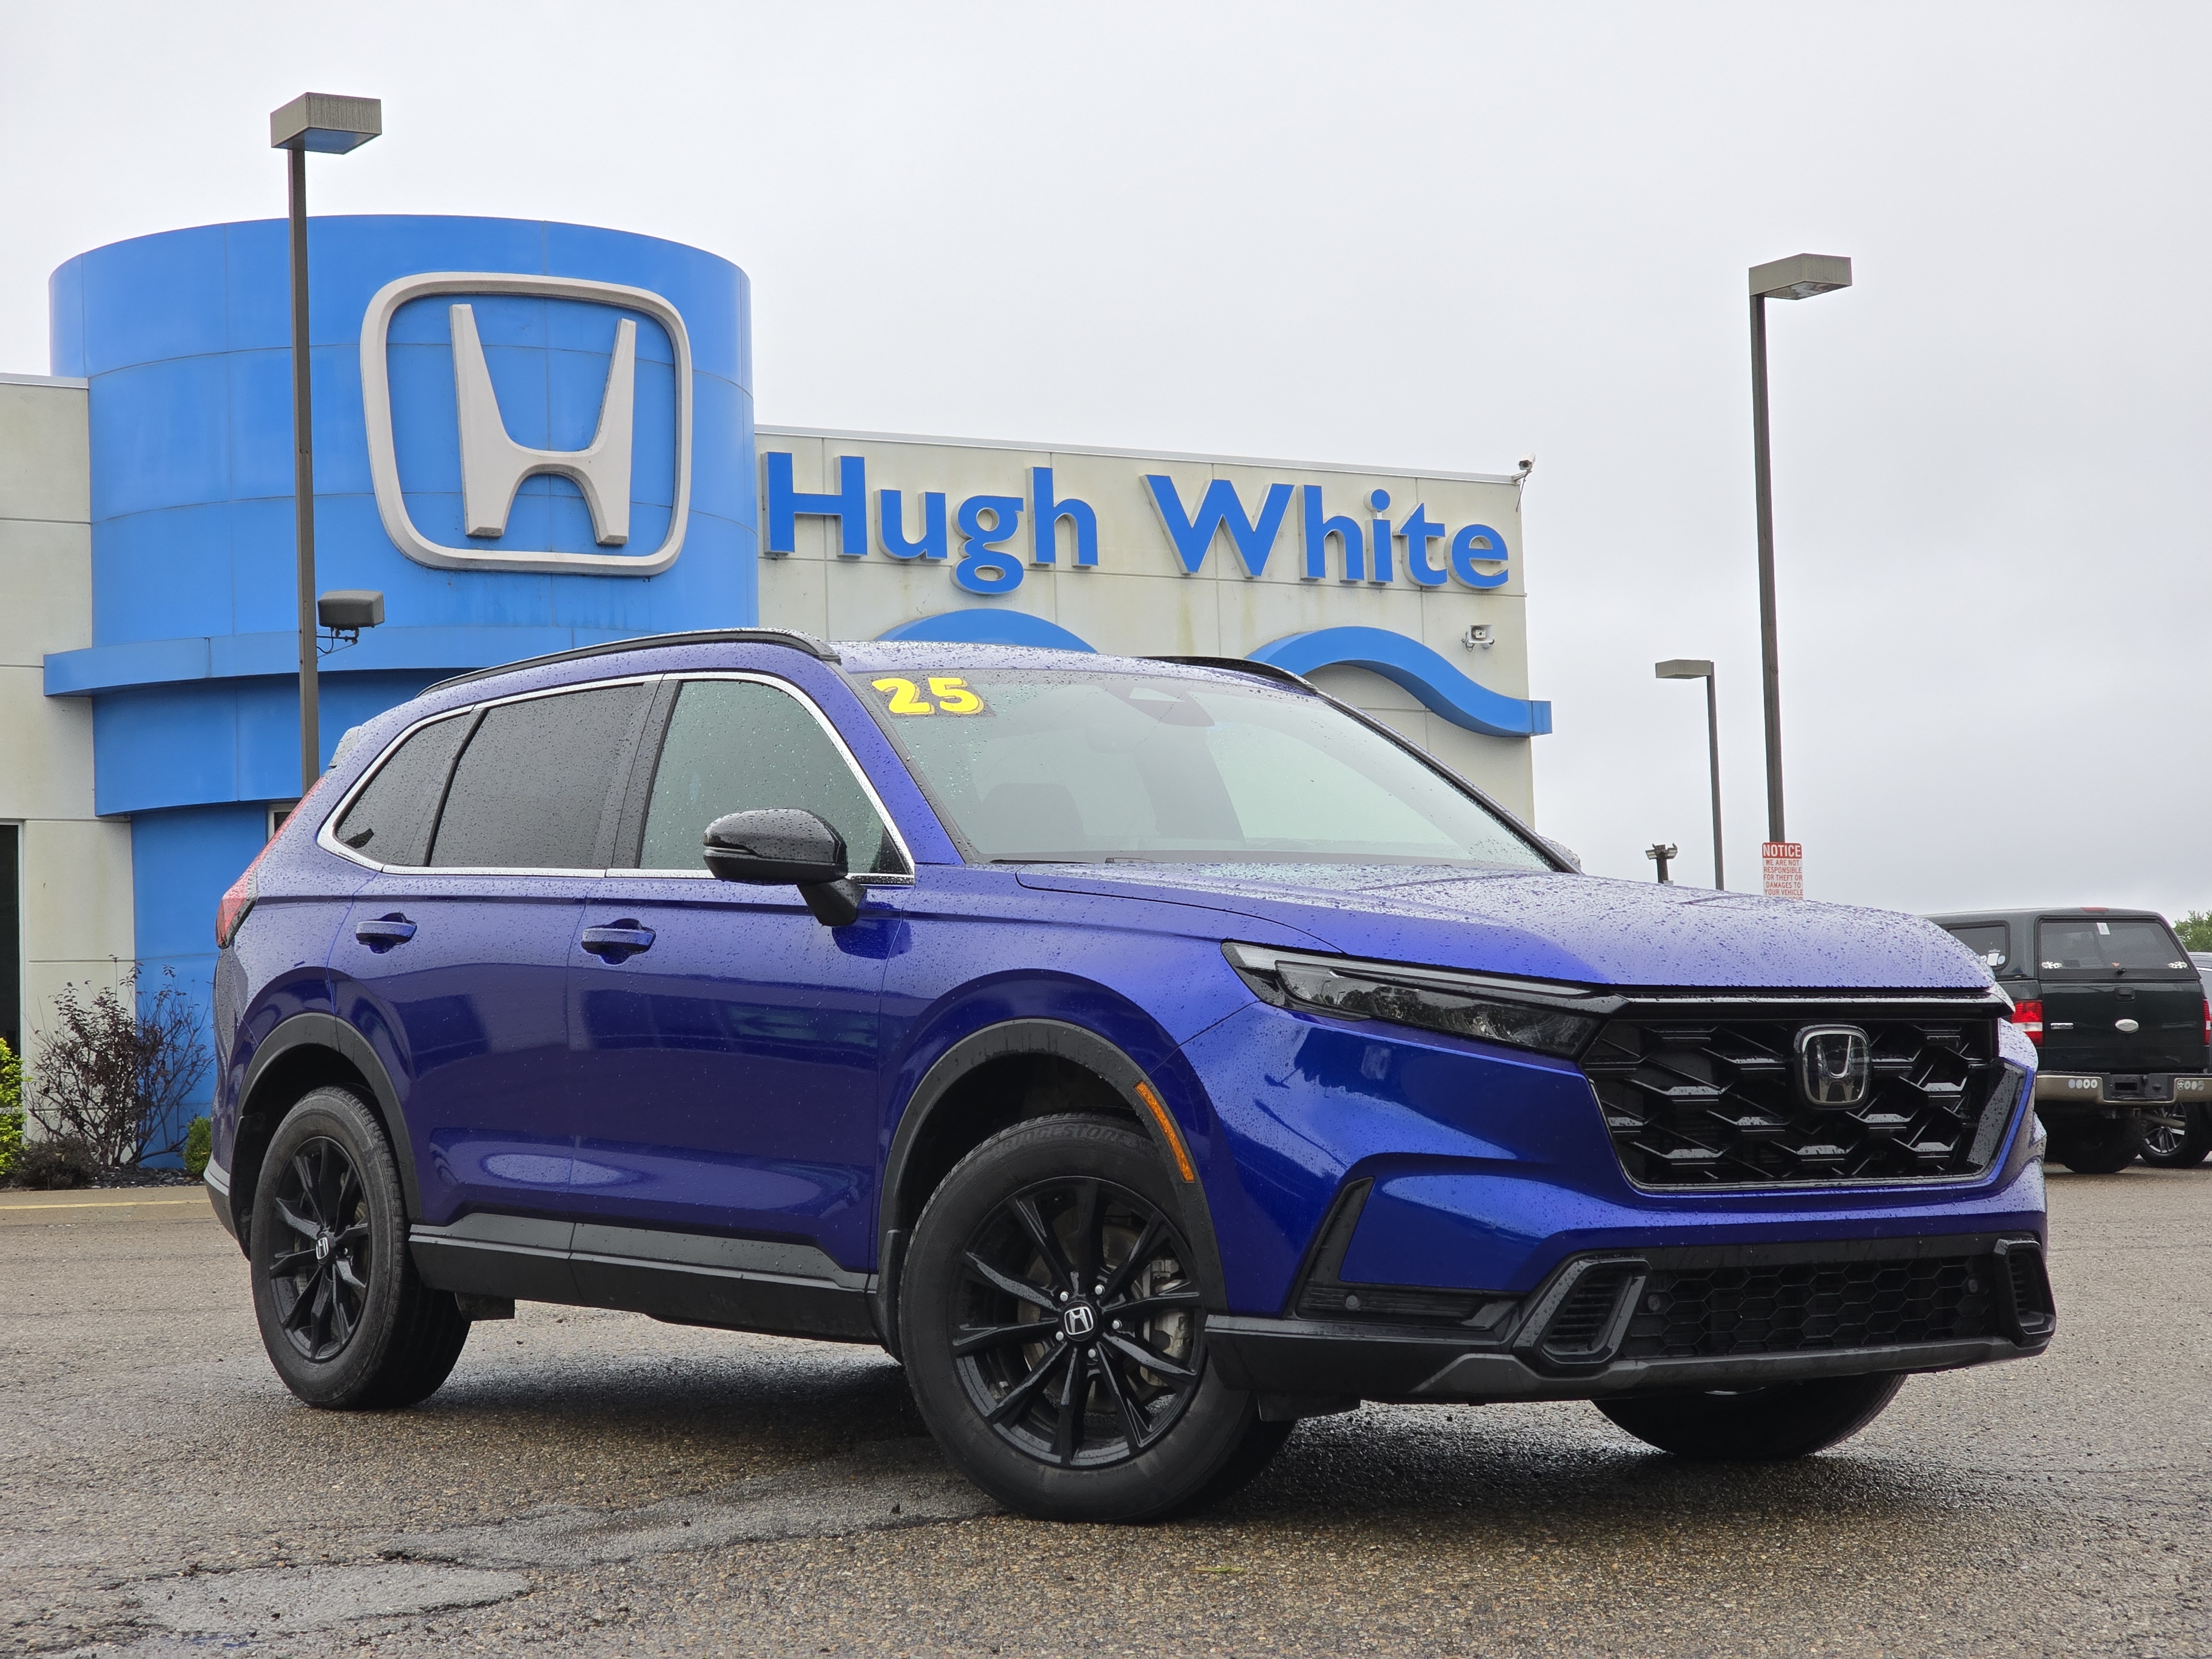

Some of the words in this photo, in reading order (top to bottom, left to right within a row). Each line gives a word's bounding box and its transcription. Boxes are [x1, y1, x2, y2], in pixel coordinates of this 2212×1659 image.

[761, 451, 1099, 595] Hugh
[1139, 474, 1510, 589] White
[871, 676, 984, 716] 25
[1763, 844, 1801, 857] NOTICE
